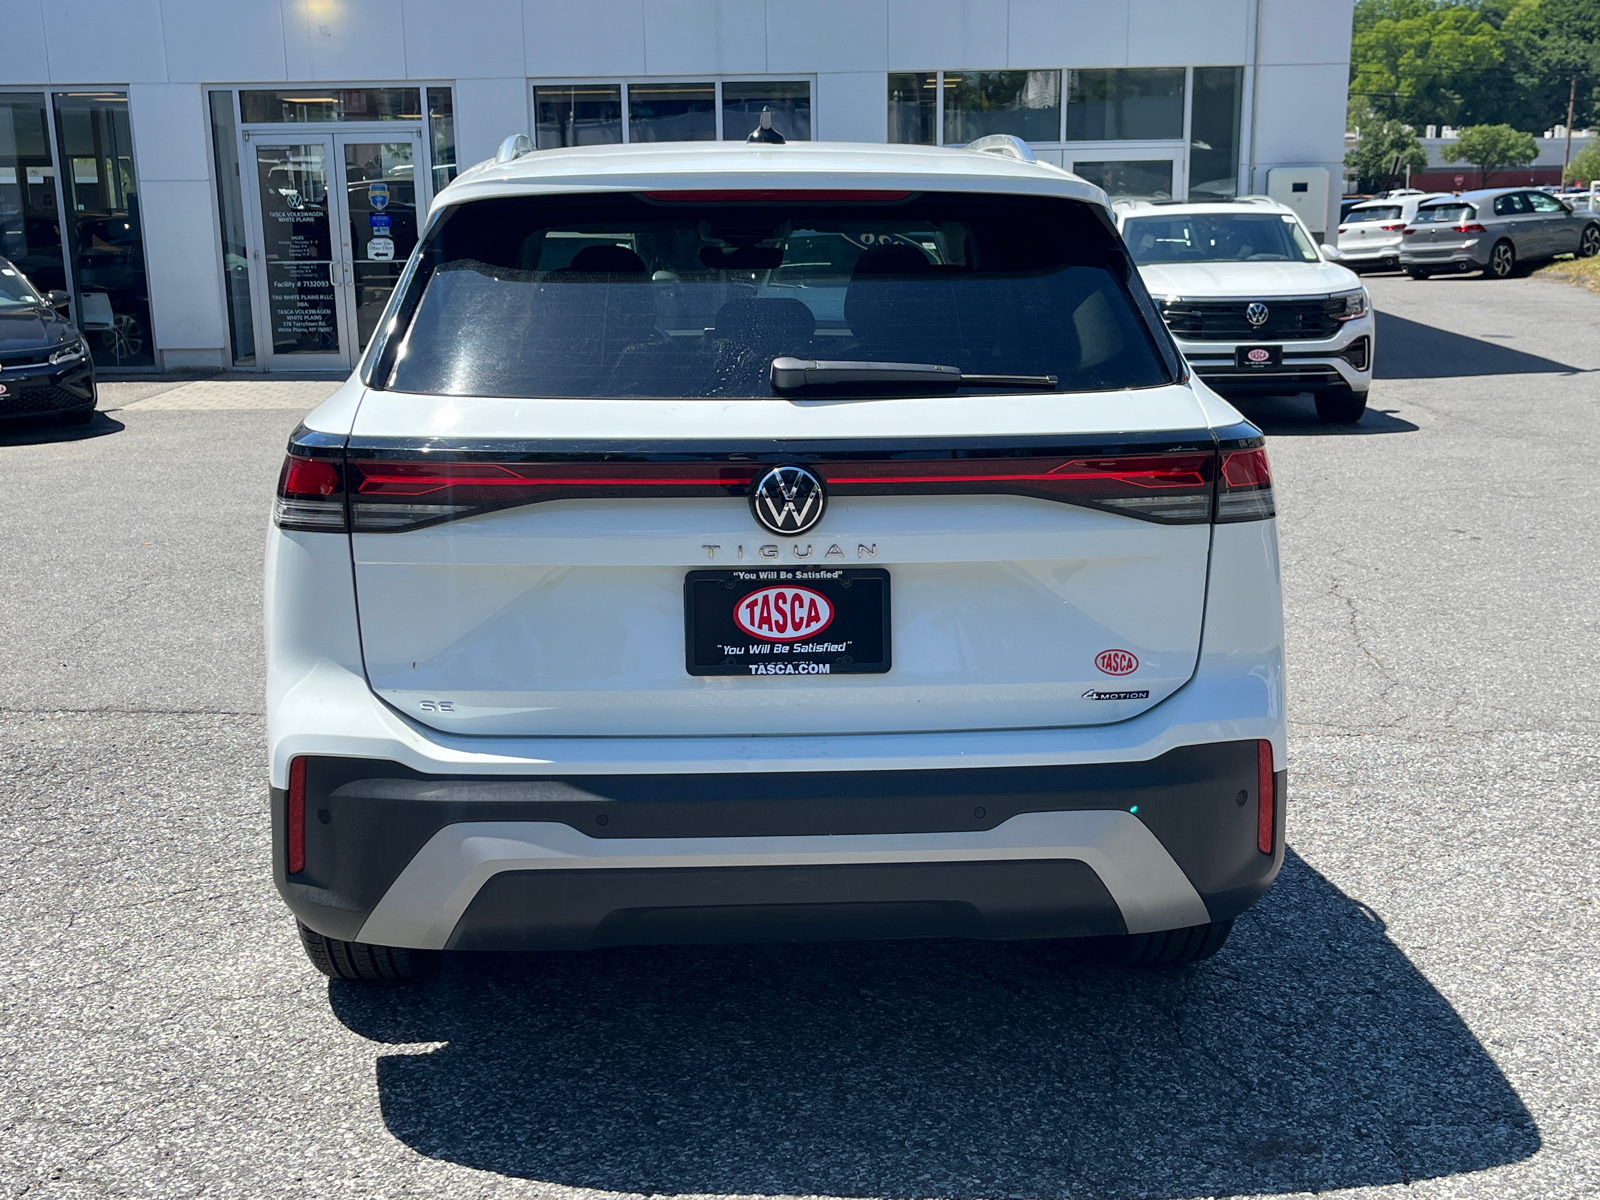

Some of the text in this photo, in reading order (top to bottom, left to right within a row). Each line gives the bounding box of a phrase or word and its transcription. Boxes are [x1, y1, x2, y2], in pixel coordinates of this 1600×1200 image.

[1250, 350, 1267, 360] TASCA
[702, 543, 877, 559] TIGUAN
[759, 571, 777, 579] Will
[745, 591, 822, 634] TASCA
[750, 644, 770, 654] Will
[773, 644, 789, 653] Be
[1100, 652, 1133, 672] TASCA
[749, 664, 830, 675] TASCA.COM
[1082, 689, 1148, 700] 4MOTION
[420, 700, 454, 713] SE
